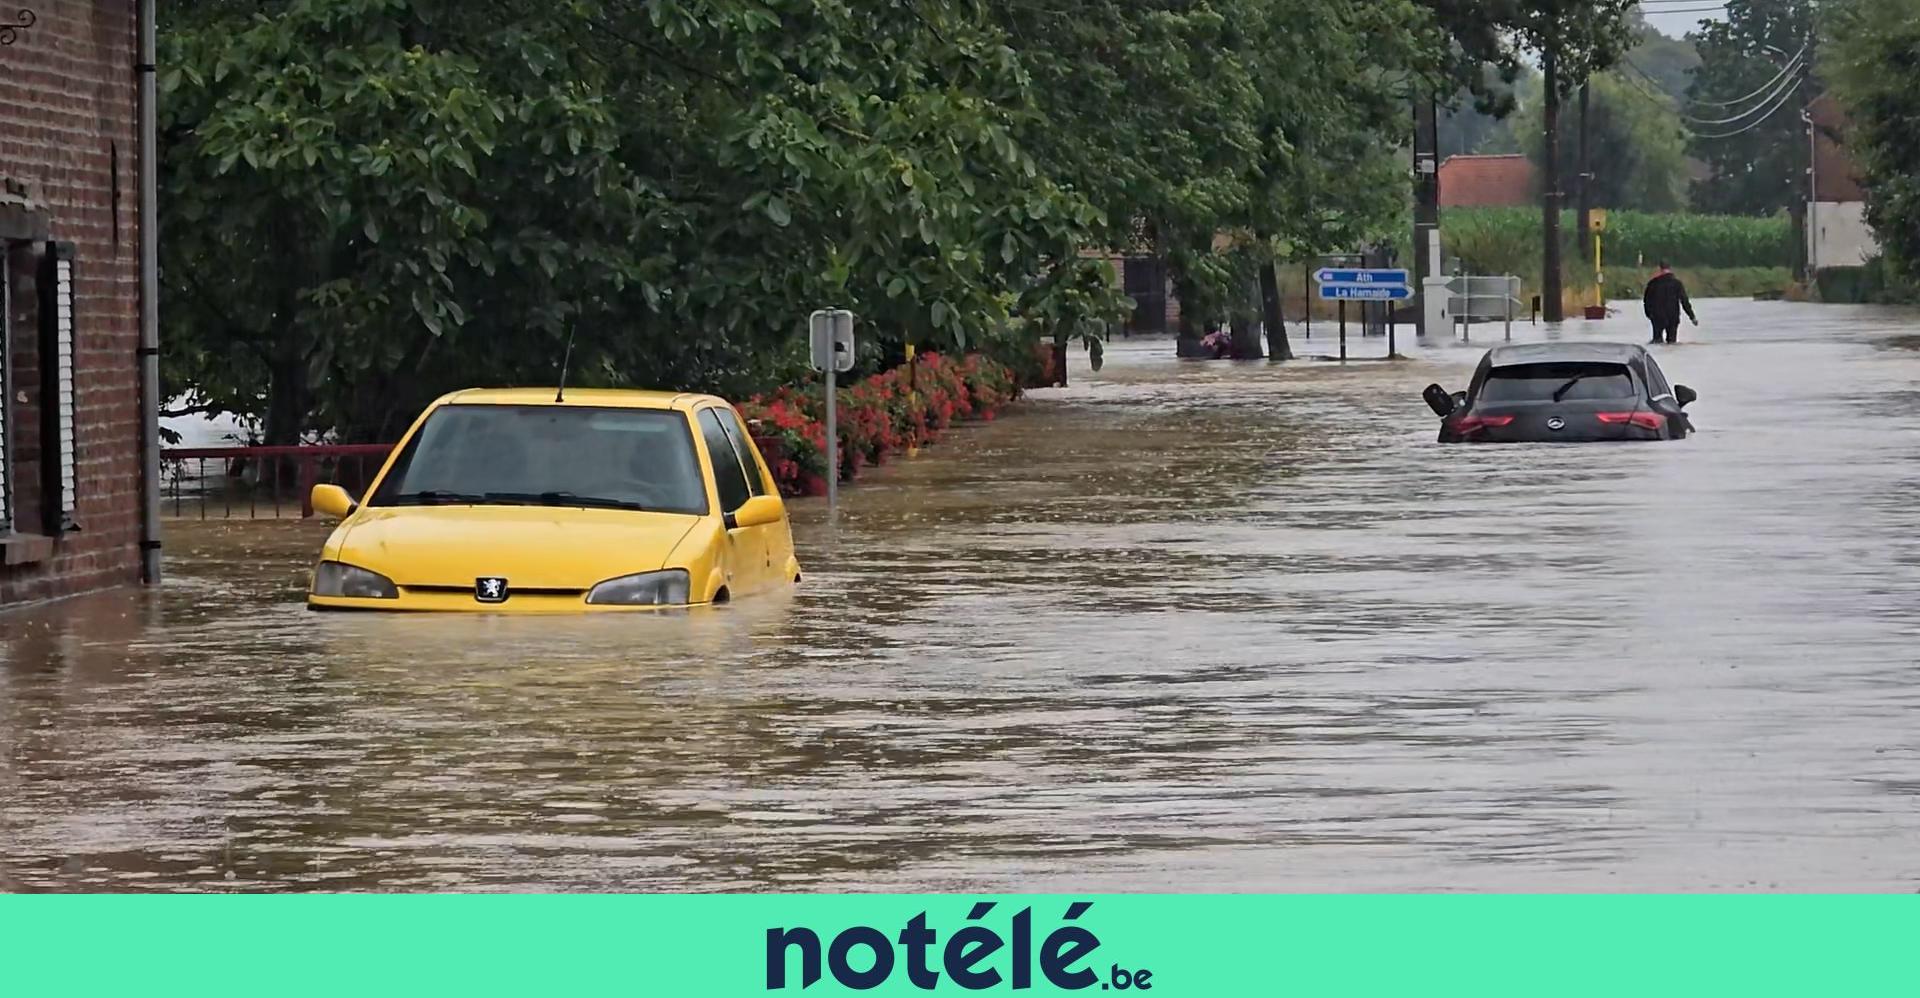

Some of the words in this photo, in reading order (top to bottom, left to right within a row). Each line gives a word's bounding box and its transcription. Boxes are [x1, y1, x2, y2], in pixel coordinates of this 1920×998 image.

[1356, 272, 1373, 282] Ath
[1336, 287, 1349, 297] La
[1350, 287, 1391, 298] Hamaide
